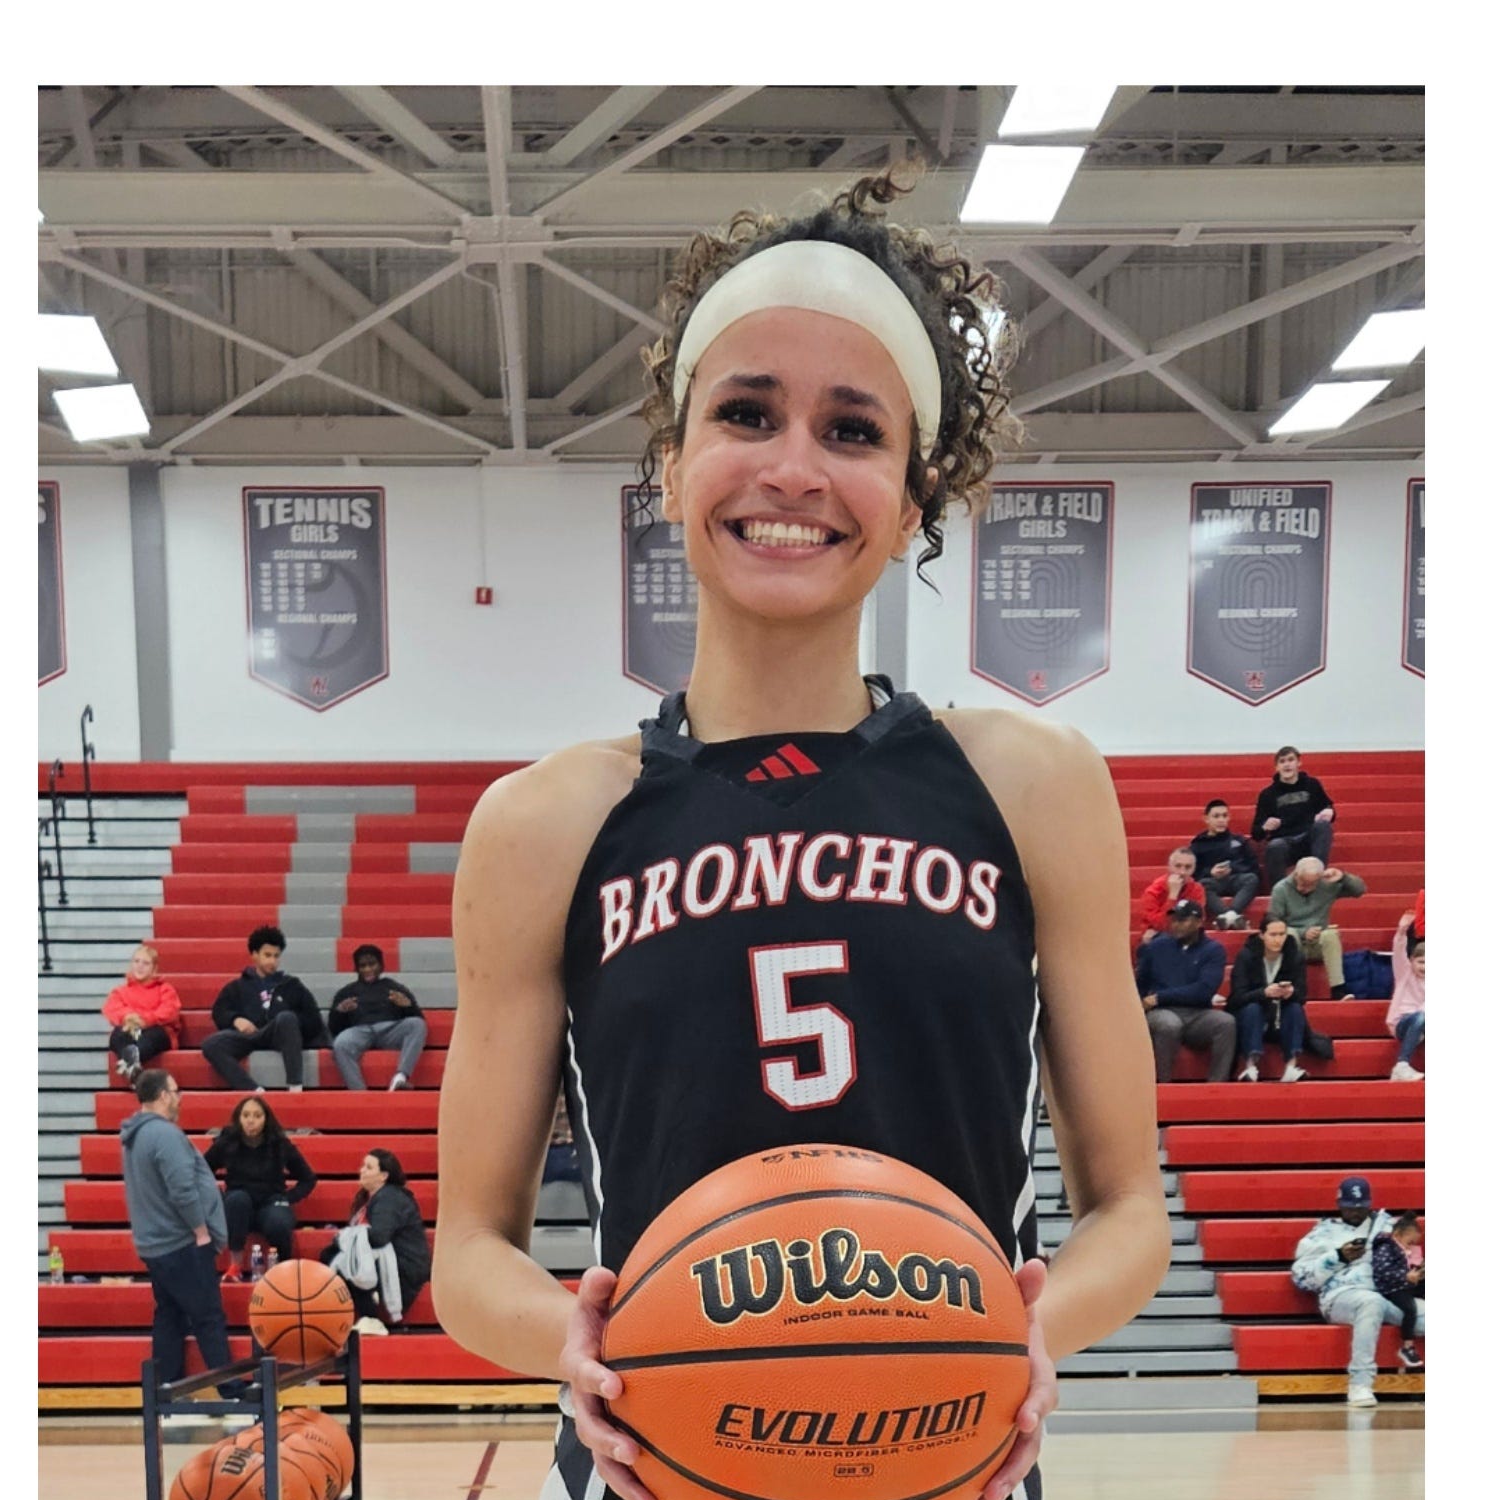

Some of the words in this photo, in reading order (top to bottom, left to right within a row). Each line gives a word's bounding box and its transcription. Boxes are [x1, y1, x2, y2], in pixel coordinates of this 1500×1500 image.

[254, 497, 372, 530] TENNIS
[1042, 495, 1054, 517] &
[1058, 492, 1103, 524] FIELD
[1229, 488, 1293, 507] UNIFIED
[290, 524, 340, 543] GIRLS
[1018, 519, 1067, 539] GIRLS
[1259, 510, 1271, 532] &
[1275, 507, 1321, 539] FIELD
[599, 831, 1002, 964] BRONCHOS
[748, 939, 858, 1112] 5
[690, 1227, 988, 1327] Wilson
[783, 1309, 843, 1326] INDOOR
[848, 1308, 890, 1317] GAME
[895, 1309, 930, 1320] BALL
[714, 1390, 987, 1446] EVOLUTION
[714, 1439, 798, 1457] ADVANCED
[804, 1447, 900, 1458] MICROFIBER
